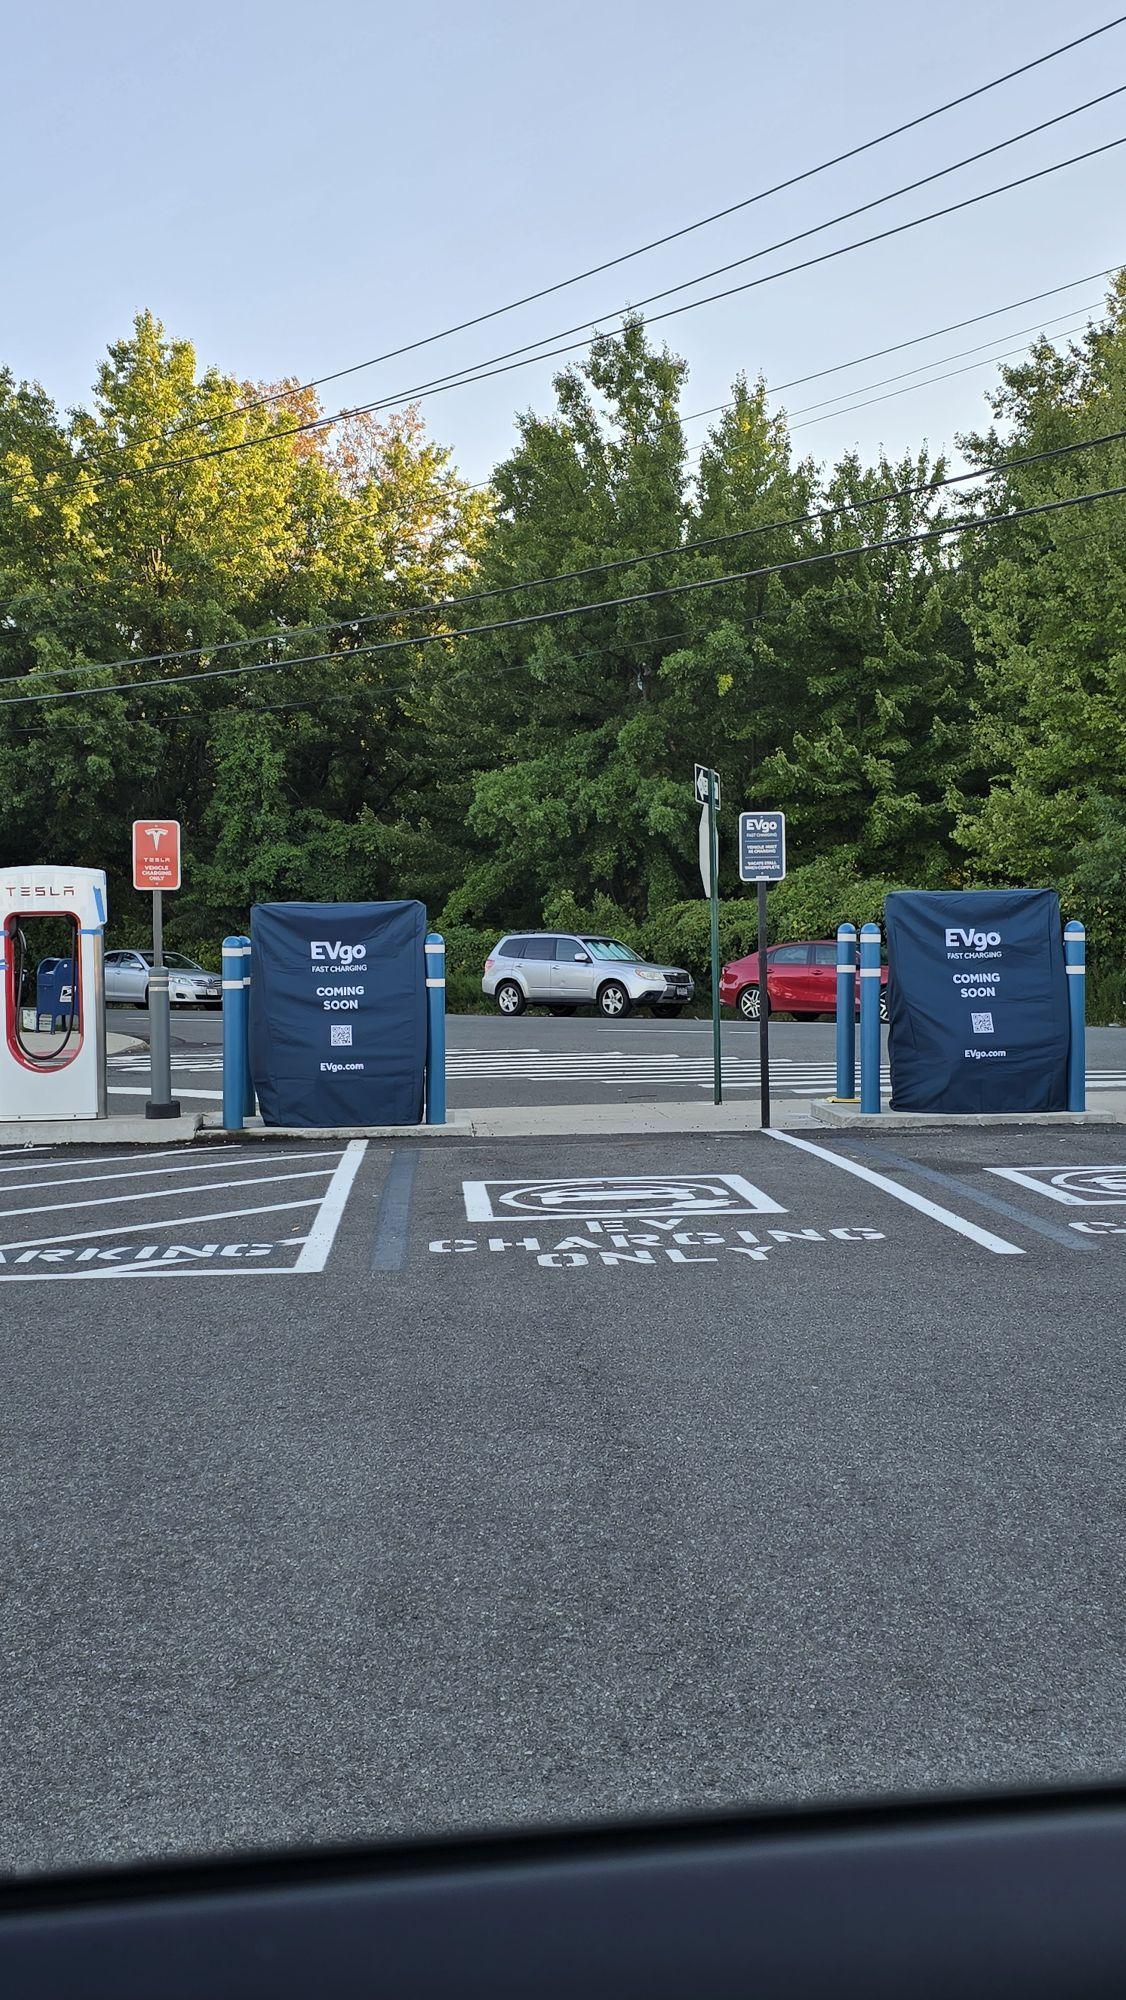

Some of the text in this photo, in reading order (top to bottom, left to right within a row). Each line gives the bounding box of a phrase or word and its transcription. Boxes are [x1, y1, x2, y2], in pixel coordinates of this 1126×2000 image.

[746, 819, 777, 833] EVgo
[5, 886, 75, 897] TESLA
[945, 928, 1001, 951] EVgo
[310, 941, 367, 964] EVgo
[947, 951, 1002, 960] FAST CHARGING
[312, 964, 367, 973] FAST CHARGING
[952, 973, 1001, 984] COMING
[316, 985, 365, 996] COMING
[960, 987, 996, 998] SOON
[323, 1000, 359, 1010] SOON
[964, 1049, 1006, 1060] EVgo.com
[320, 1062, 364, 1073] EVgo.com
[585, 1218, 685, 1233] EV
[428, 1227, 886, 1253] CHARGING
[0, 1243, 273, 1264] RKING
[537, 1246, 774, 1268] ONLY
